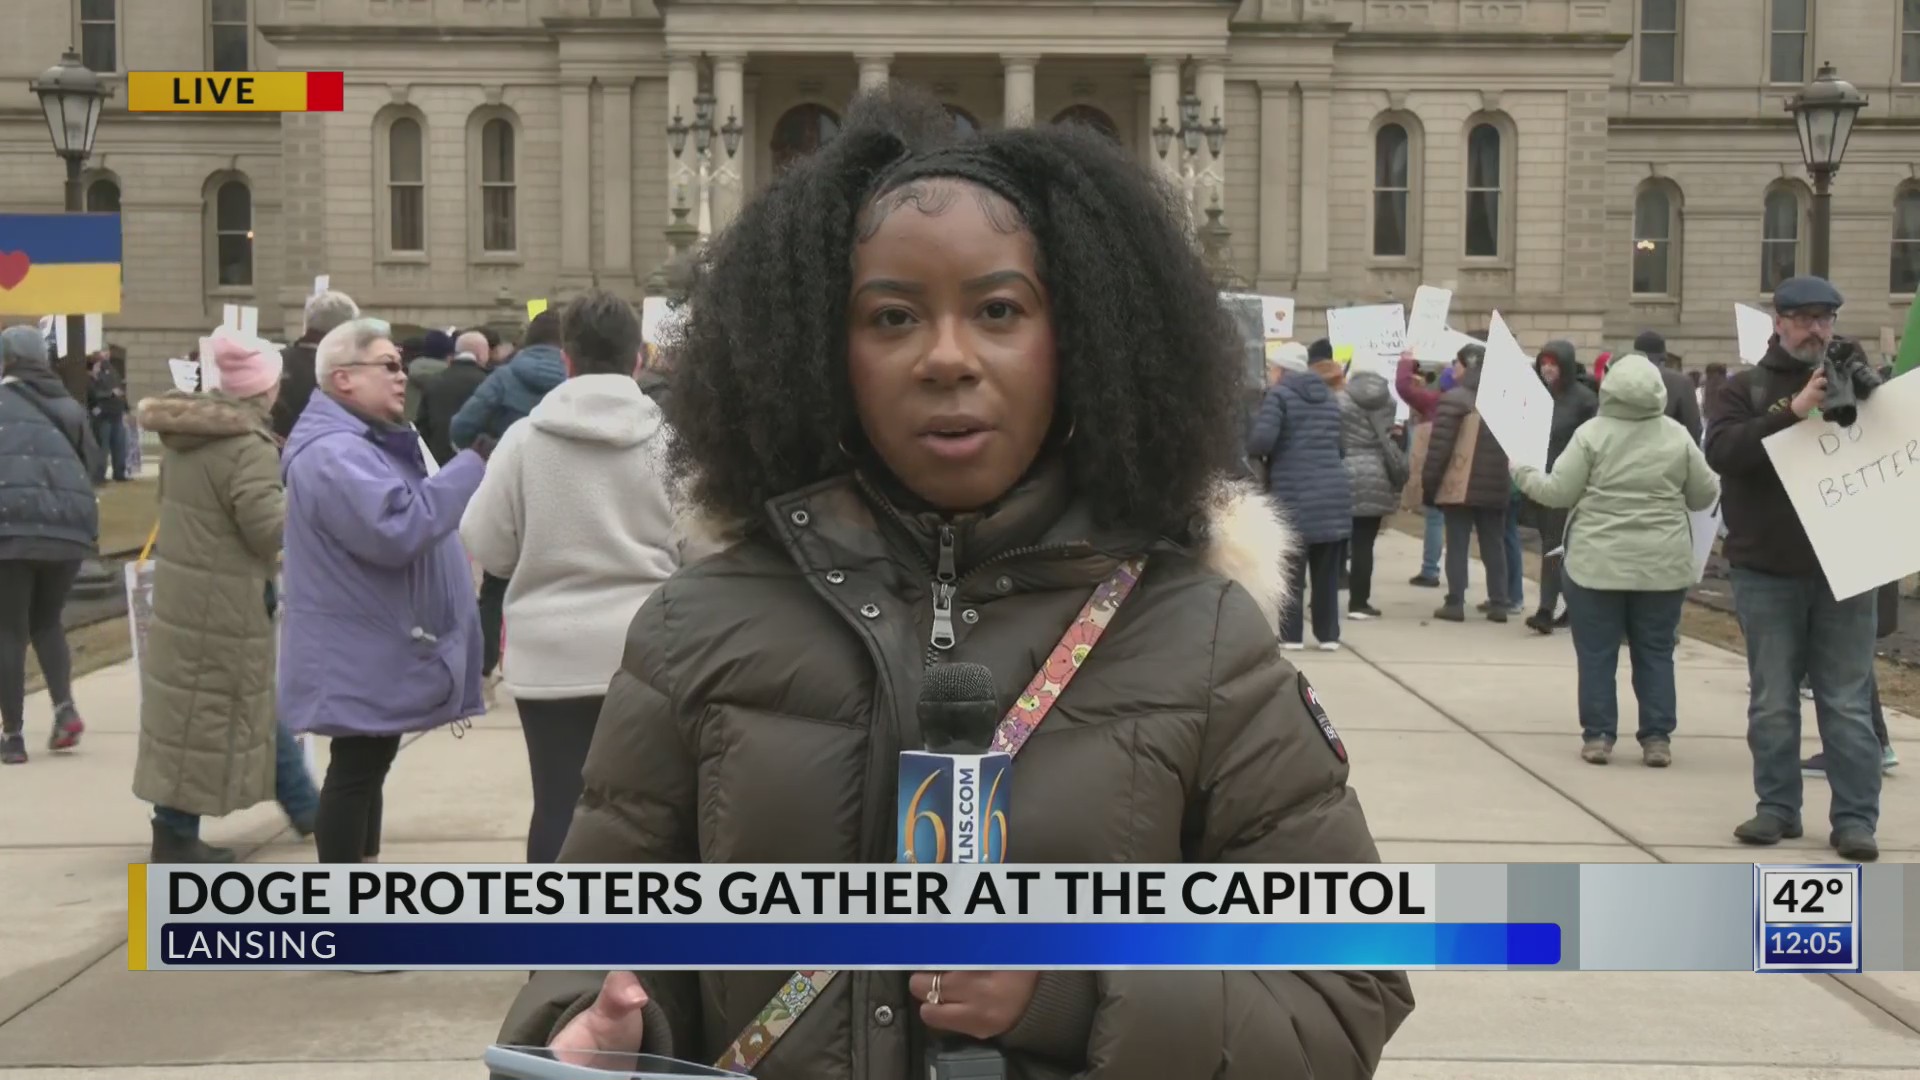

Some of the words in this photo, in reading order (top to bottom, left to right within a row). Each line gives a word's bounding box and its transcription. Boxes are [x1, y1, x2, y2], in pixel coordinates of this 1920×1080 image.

[1817, 439, 1920, 508] BETTER
[1818, 424, 1863, 456] DO
[958, 767, 975, 864] LNS.COM
